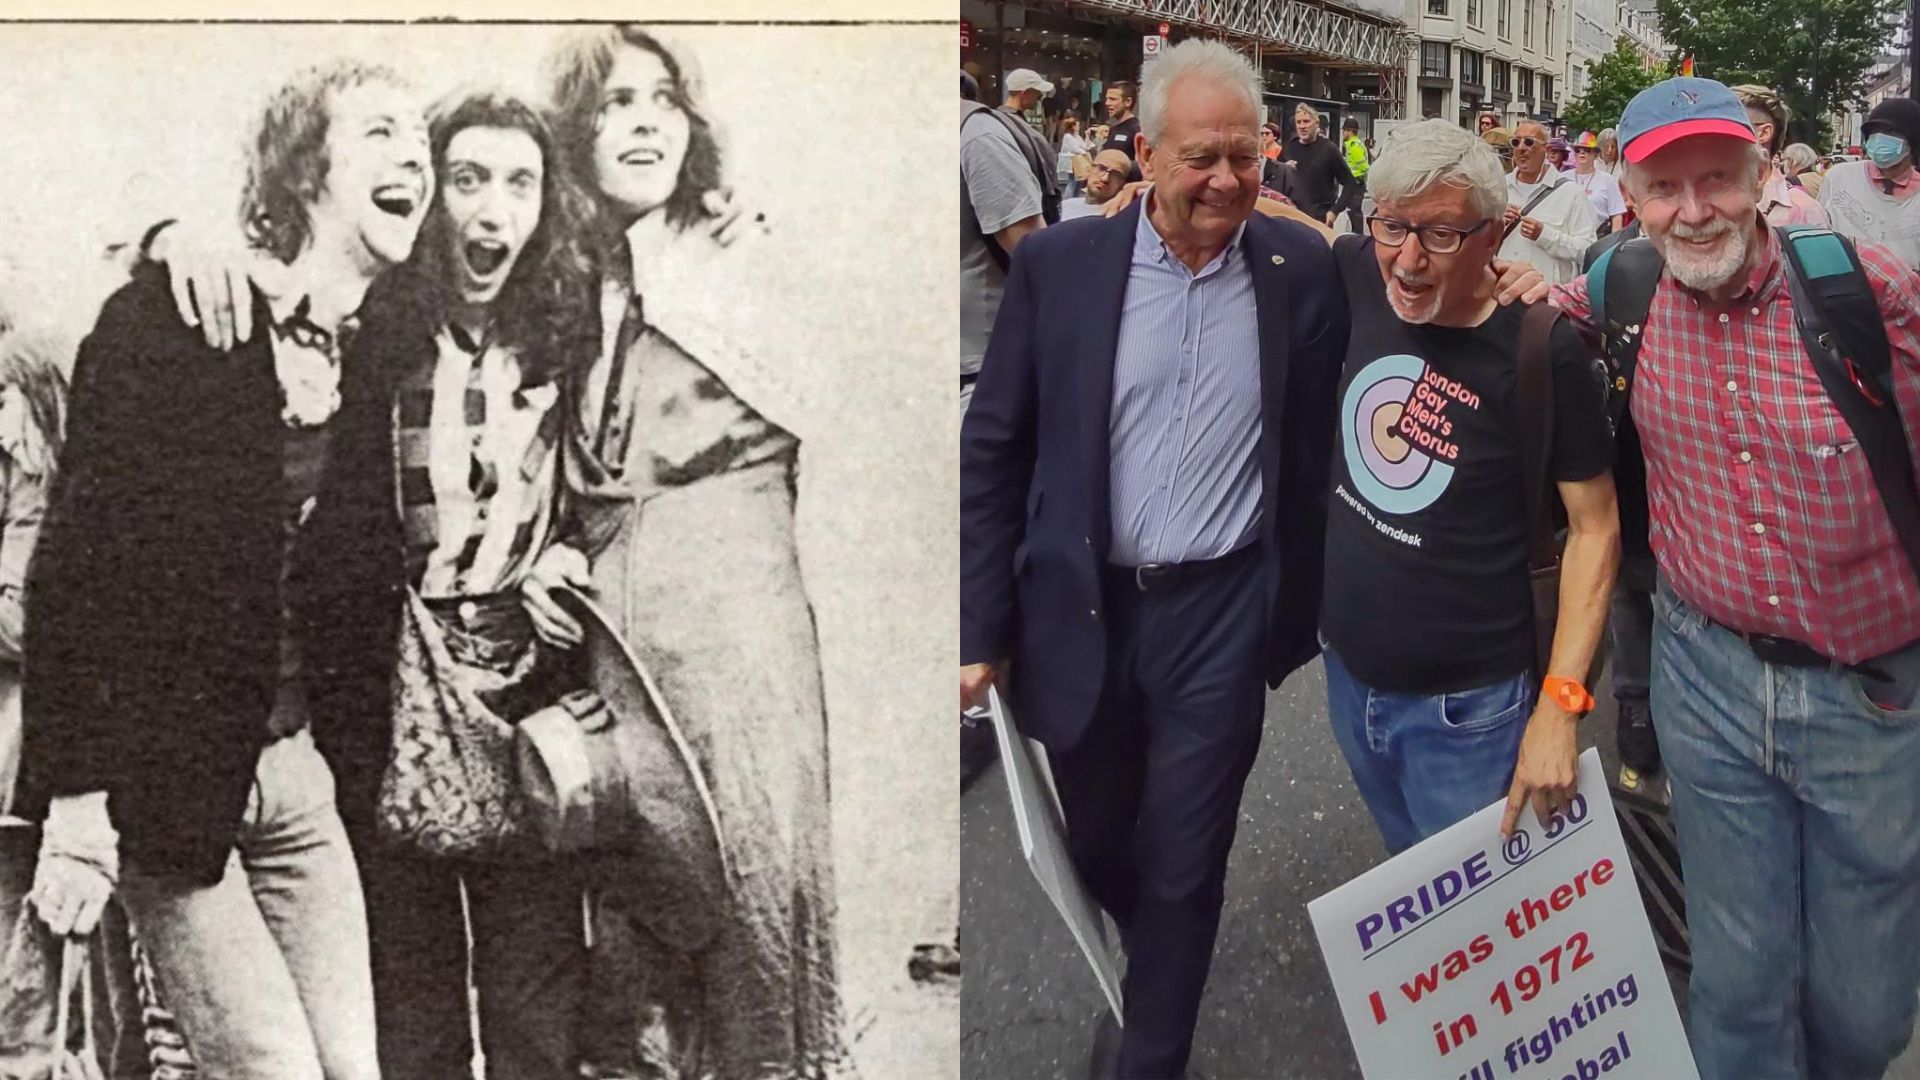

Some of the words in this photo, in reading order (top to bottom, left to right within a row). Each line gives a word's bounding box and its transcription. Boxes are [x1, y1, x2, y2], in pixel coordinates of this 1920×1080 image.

[1406, 397, 1452, 436] Men's
[1416, 382, 1448, 413] Gay
[1424, 364, 1479, 410] London
[1400, 415, 1459, 459] Chorus
[1335, 484, 1366, 516] powered
[1366, 509, 1376, 525] by
[1375, 520, 1422, 547] zendesk
[1355, 850, 1492, 951] PRIDE
[1502, 829, 1533, 865] @
[1368, 990, 1387, 1025] I
[1400, 934, 1494, 1004] was
[1505, 858, 1615, 939] there
[1433, 1013, 1478, 1057] in
[1490, 931, 1594, 1016] 1972
[1504, 973, 1639, 1073] fighting
